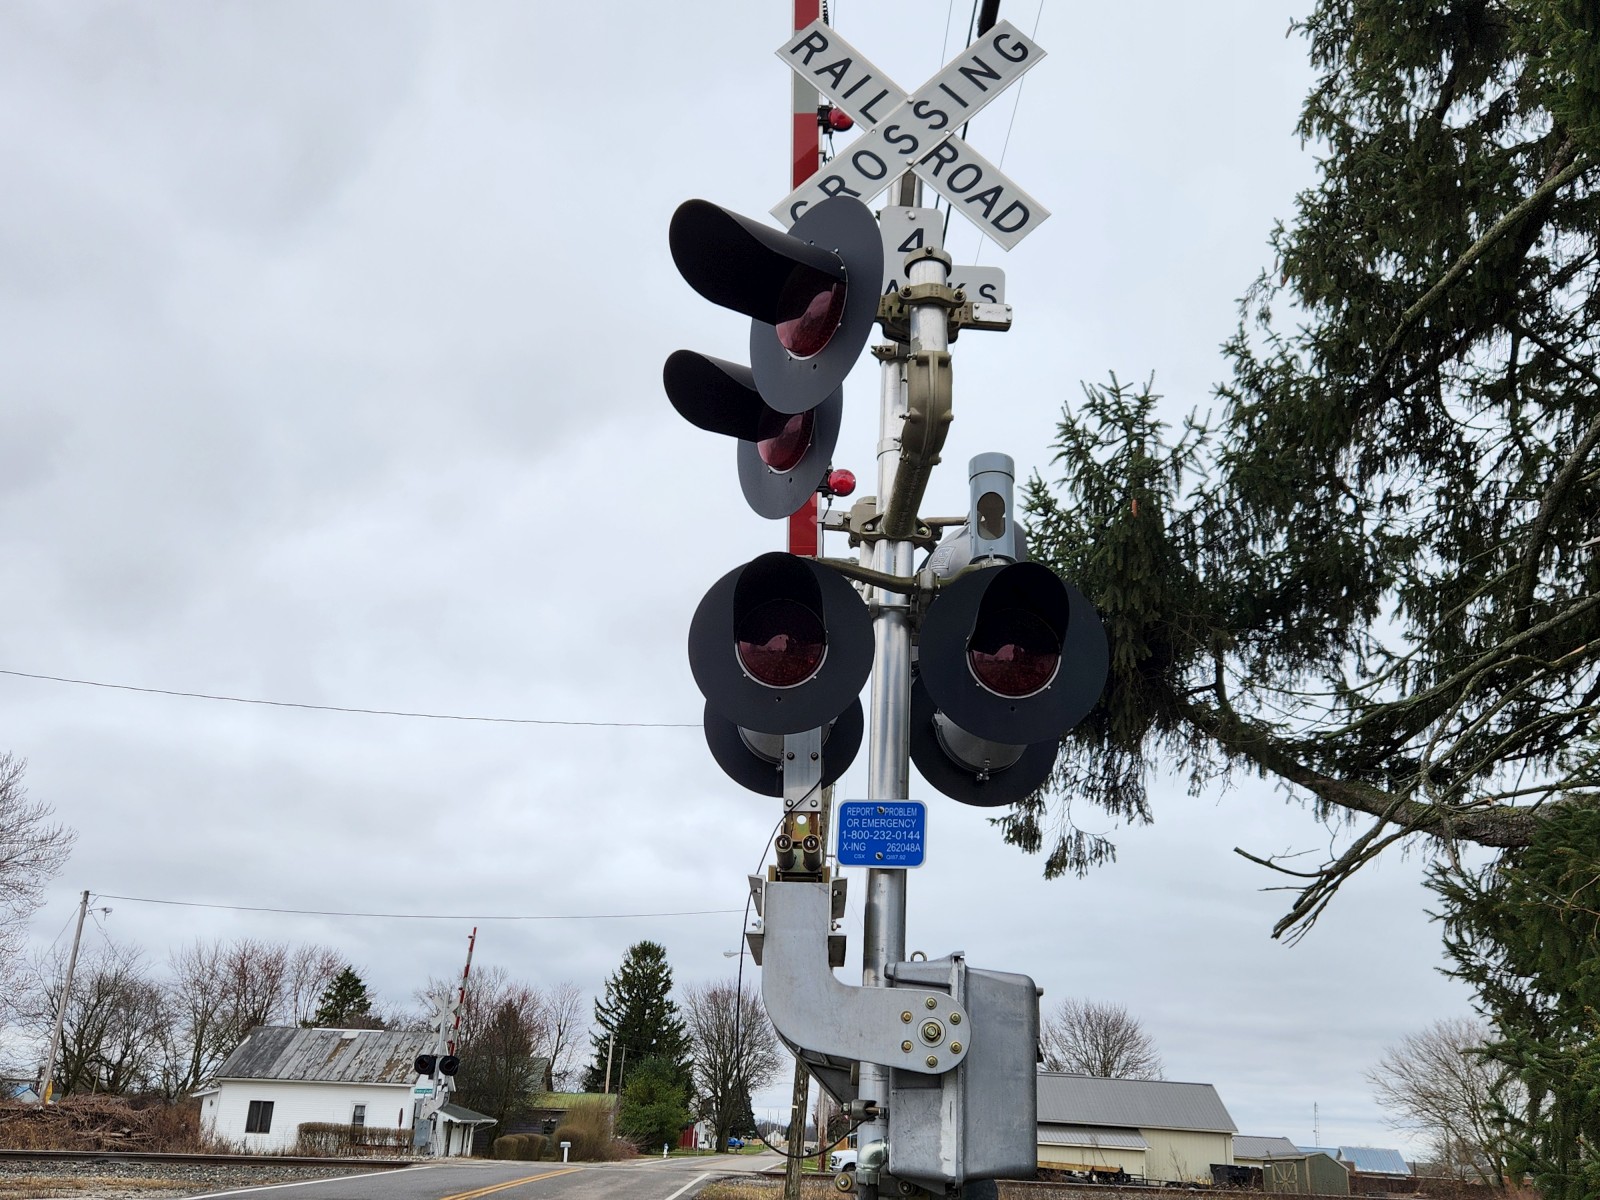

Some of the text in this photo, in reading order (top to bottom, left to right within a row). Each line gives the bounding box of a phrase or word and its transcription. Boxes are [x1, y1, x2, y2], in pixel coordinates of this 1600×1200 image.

[790, 30, 1030, 233] RAIL ROAD
[897, 227, 925, 252] 4
[846, 806, 917, 817] REPORT PROBLEM
[846, 818, 917, 828] OR EMERGENCY
[842, 830, 920, 840] 1-800-232-0144
[842, 842, 921, 852] X-ING 262048A
